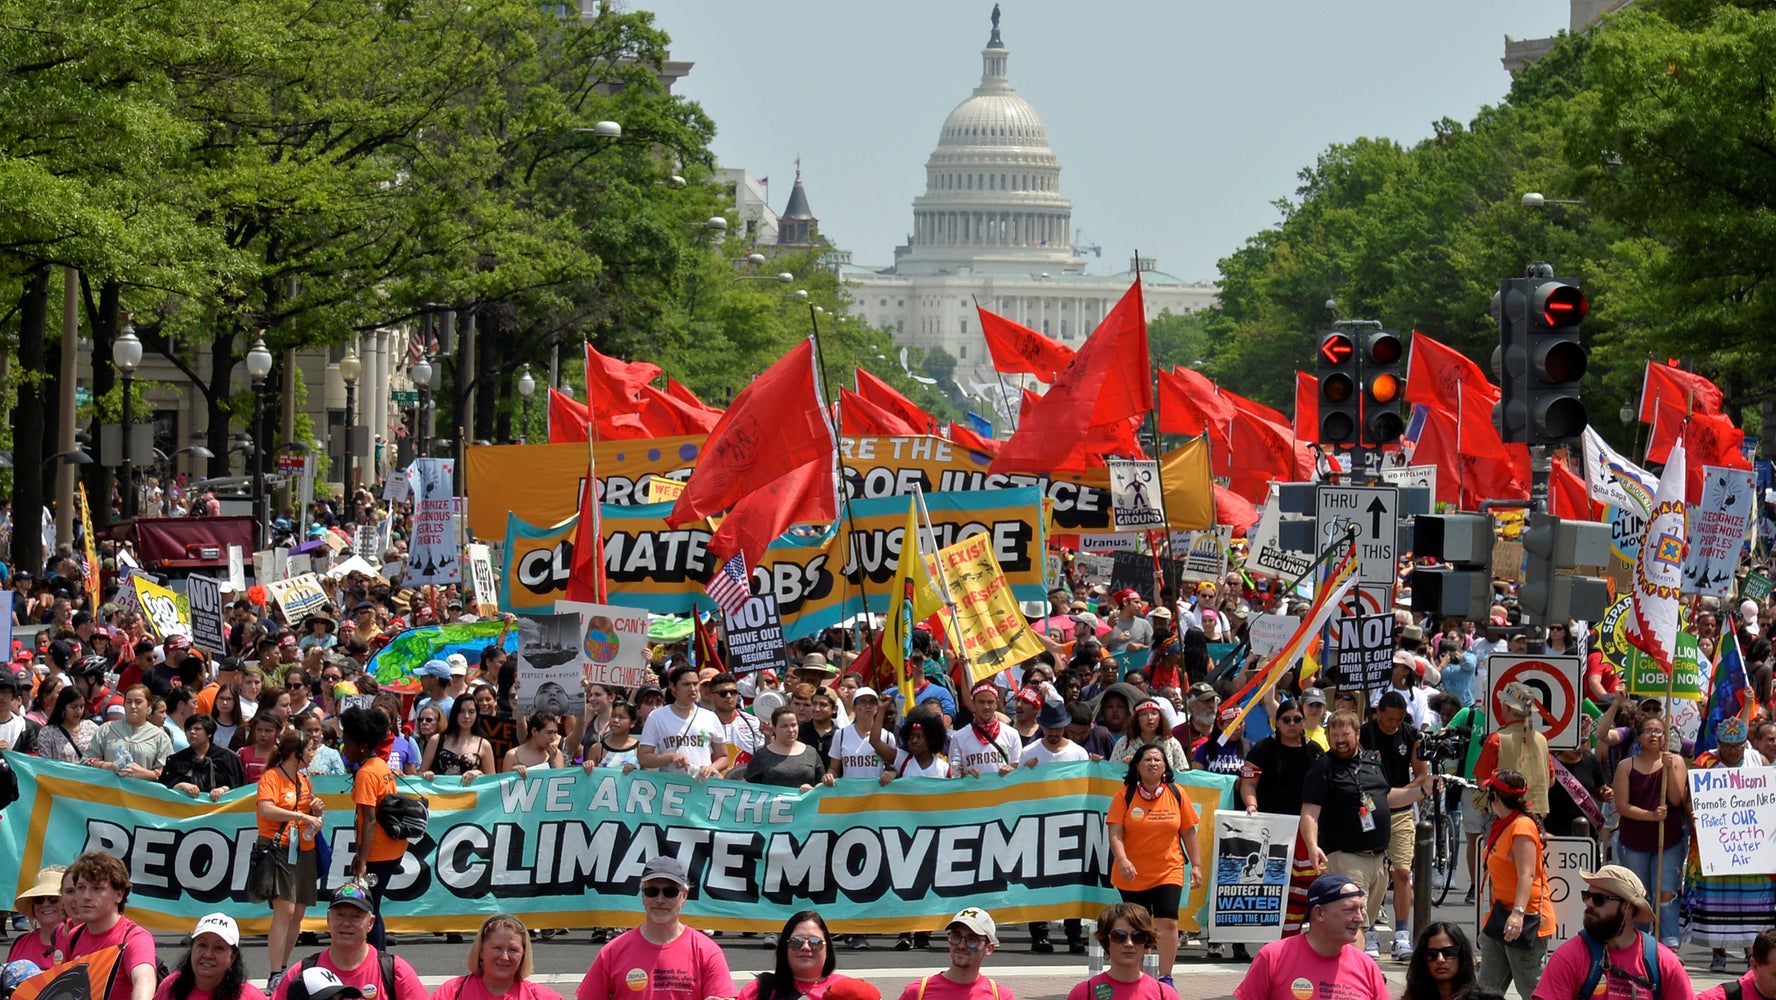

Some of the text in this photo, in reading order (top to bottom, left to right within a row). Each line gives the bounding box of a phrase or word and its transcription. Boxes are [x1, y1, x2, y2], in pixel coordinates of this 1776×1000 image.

[892, 437, 953, 462] THE
[862, 467, 924, 498] OF
[1400, 470, 1432, 478] PIPELINES!
[1324, 494, 1358, 508] THRU
[1593, 484, 1627, 501] Siha Sapa
[1117, 515, 1161, 525] GROUND
[1084, 538, 1132, 548] Uranus.
[948, 538, 988, 572] EXIST
[1362, 544, 1391, 560] THIS
[1260, 556, 1306, 576] GROUND
[189, 578, 218, 614] NO!
[962, 575, 1007, 610] RESIST
[724, 594, 777, 632] NO!
[614, 617, 646, 634] CAN't
[964, 614, 1018, 650] WE RISE
[1341, 616, 1392, 650] NO!
[728, 627, 780, 646] DRIVE OUT
[730, 638, 784, 656] TRUMP/PENCE
[1374, 648, 1392, 661] OUT
[742, 650, 774, 663] REGIME!
[663, 736, 704, 748] UPROSE
[1694, 770, 1728, 793] Mni
[500, 776, 802, 824] WE ARE THE
[1693, 797, 1727, 811] Promote
[1730, 794, 1756, 808] Green
[1701, 809, 1758, 828] Protect OUR
[1719, 826, 1765, 844] Earth
[435, 820, 757, 893] CLIMATE
[763, 811, 1110, 895] MOVEMEN
[1723, 841, 1760, 853] Water
[1559, 852, 1589, 869] USE
[1732, 854, 1751, 867] Air
[1218, 885, 1281, 896] PROTECT THE
[1218, 897, 1280, 910] WATER
[959, 910, 979, 919] M
[1216, 913, 1279, 923] DEFEND THE LAND
[320, 970, 338, 983] W
